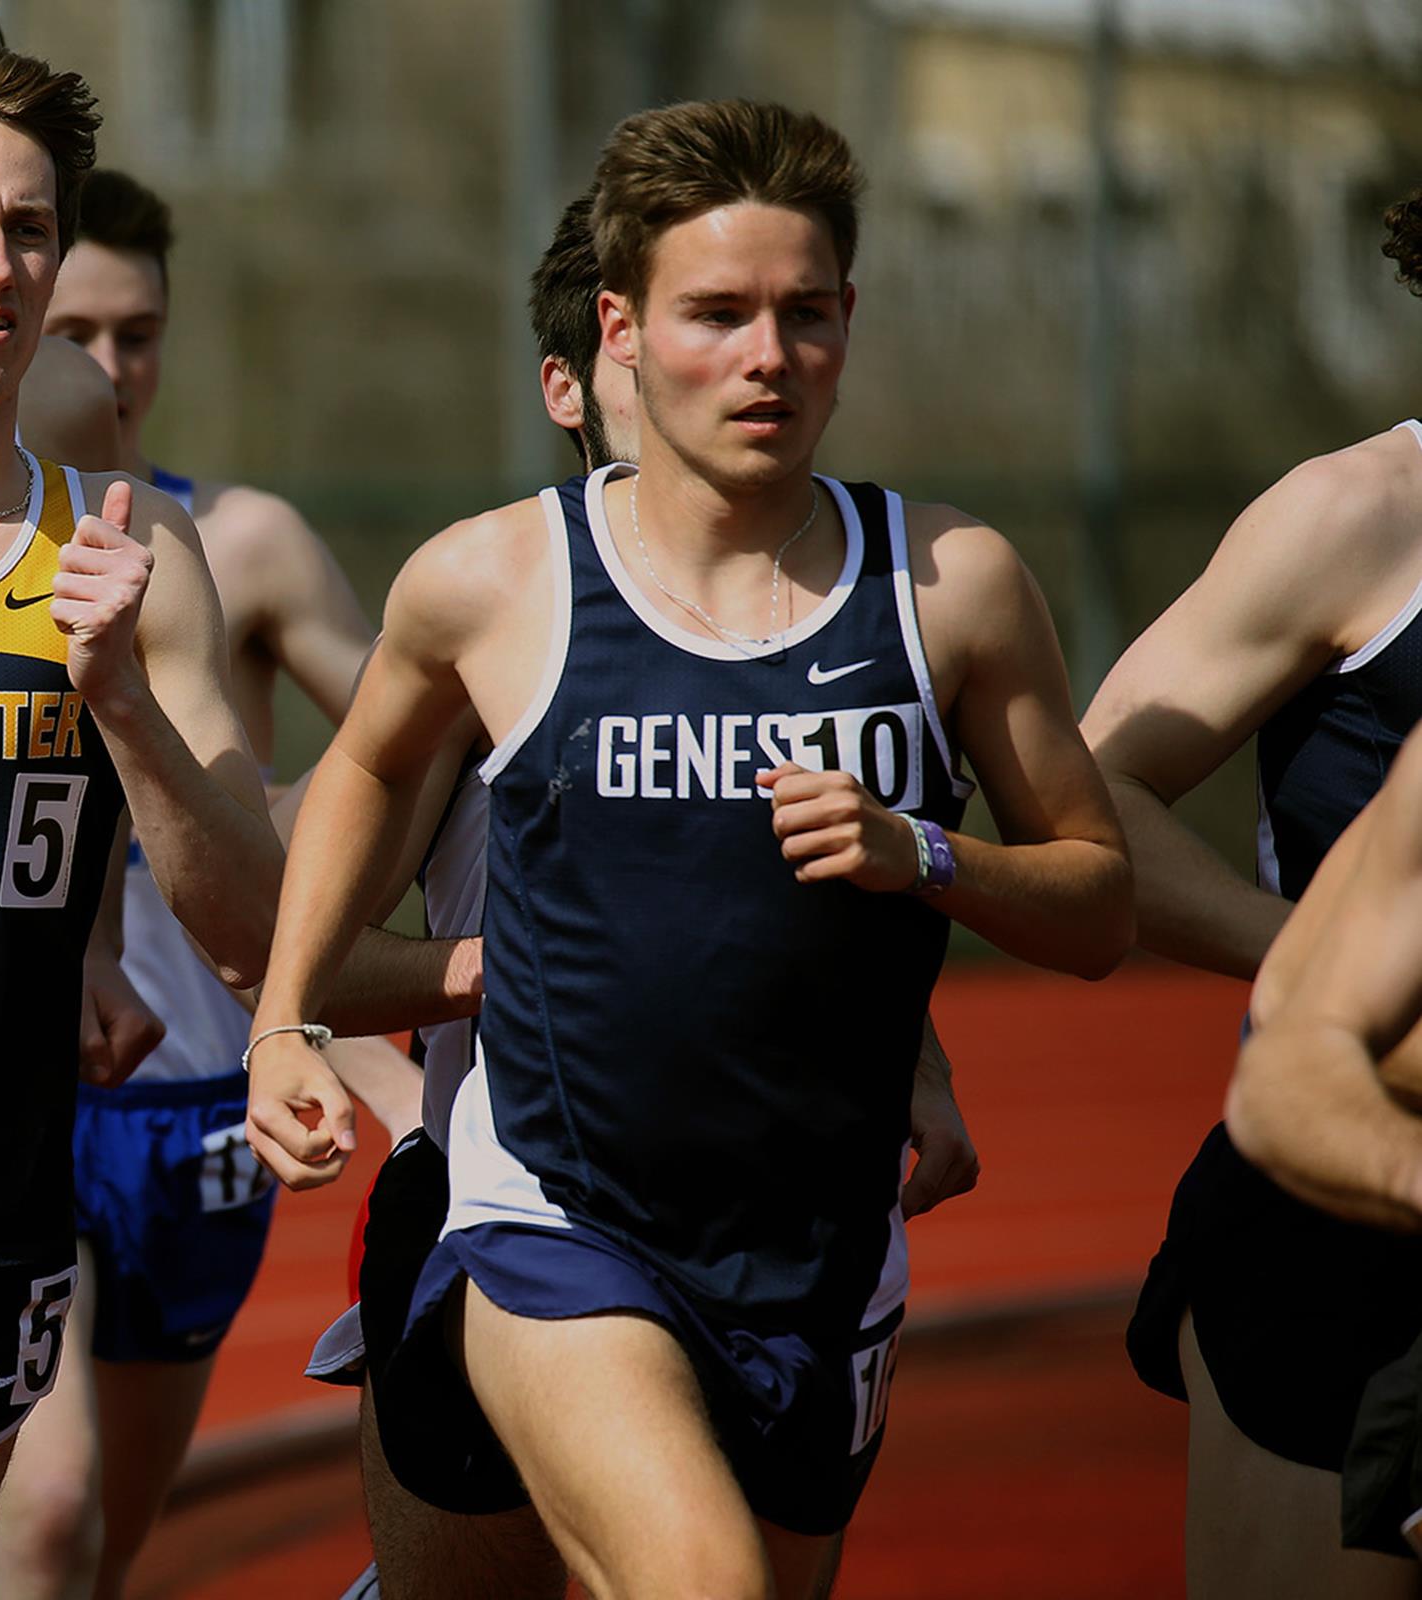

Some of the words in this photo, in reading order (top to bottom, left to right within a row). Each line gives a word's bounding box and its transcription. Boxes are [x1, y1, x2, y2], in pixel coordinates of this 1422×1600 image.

[596, 713, 798, 799] GENES
[803, 711, 908, 808] 10
[12, 782, 72, 898] 5
[24, 1277, 72, 1392] 5
